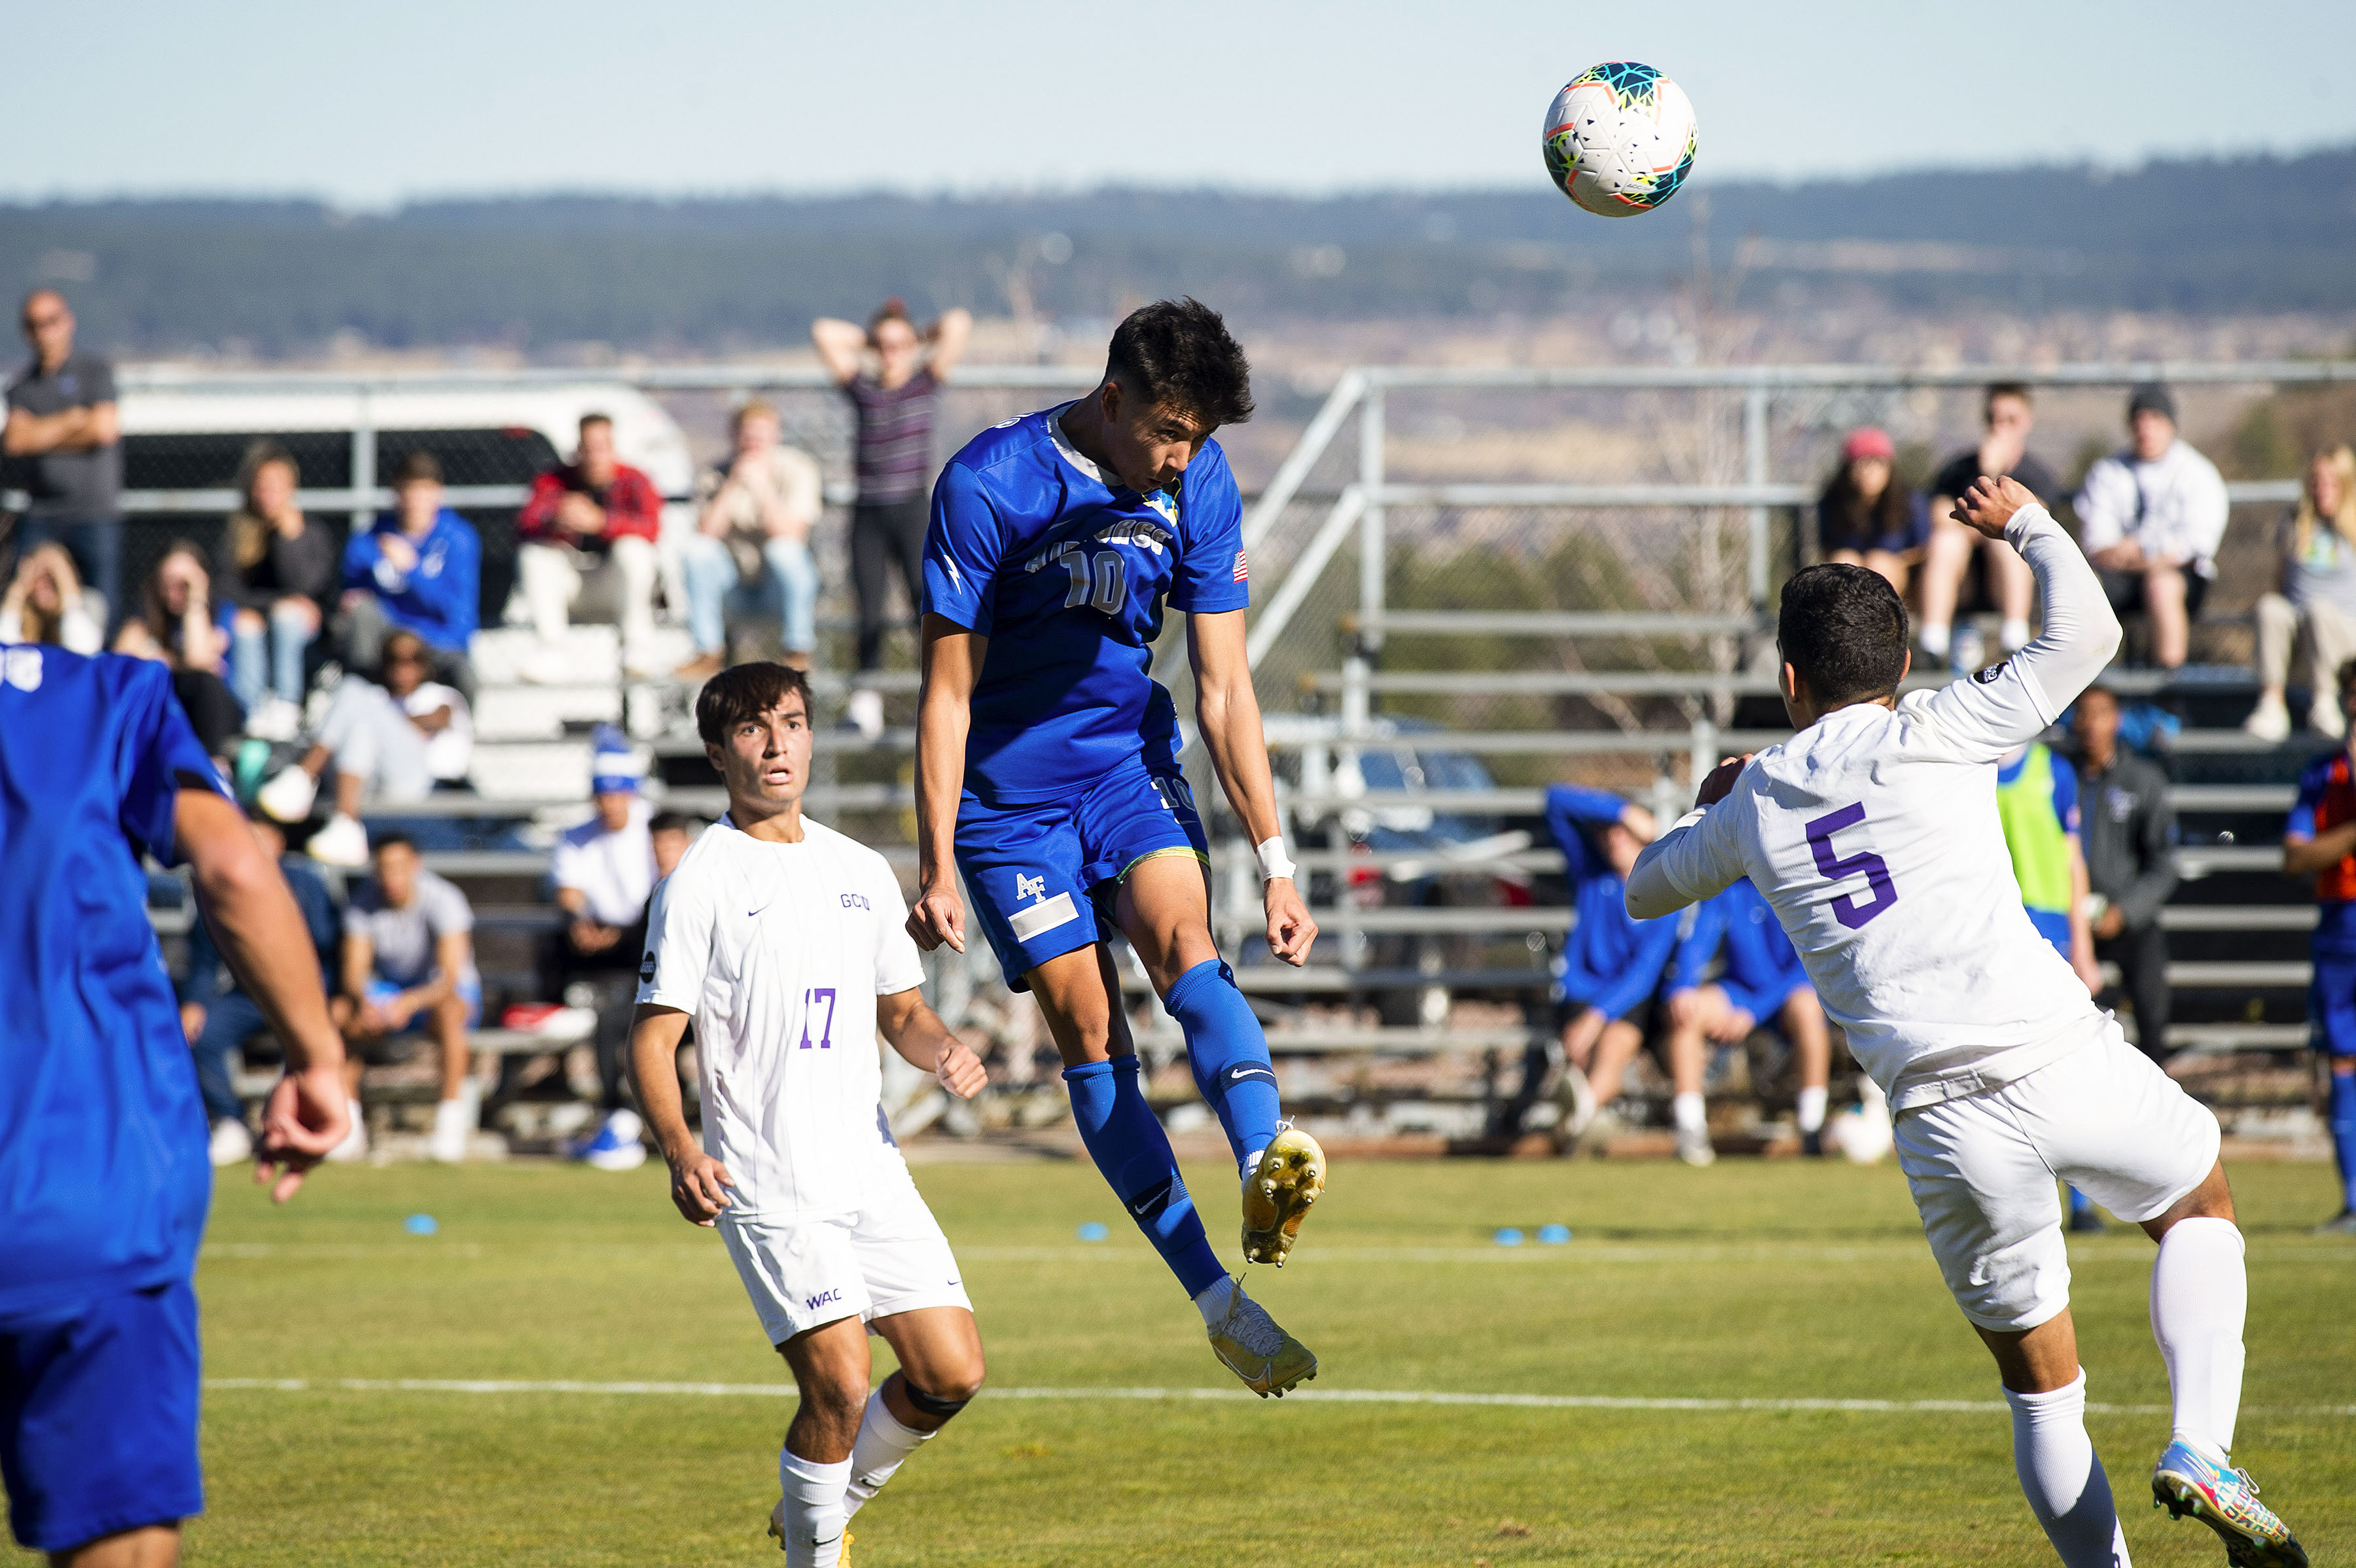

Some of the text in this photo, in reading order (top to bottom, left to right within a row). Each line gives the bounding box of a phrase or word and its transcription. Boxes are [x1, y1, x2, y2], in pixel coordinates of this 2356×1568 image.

[1060, 550, 1126, 615] 10
[1016, 872, 1046, 904] AF
[1806, 801, 1899, 930] 5
[840, 893, 870, 911] GCU
[800, 988, 836, 1050] 17
[806, 1288, 842, 1310] WAC
